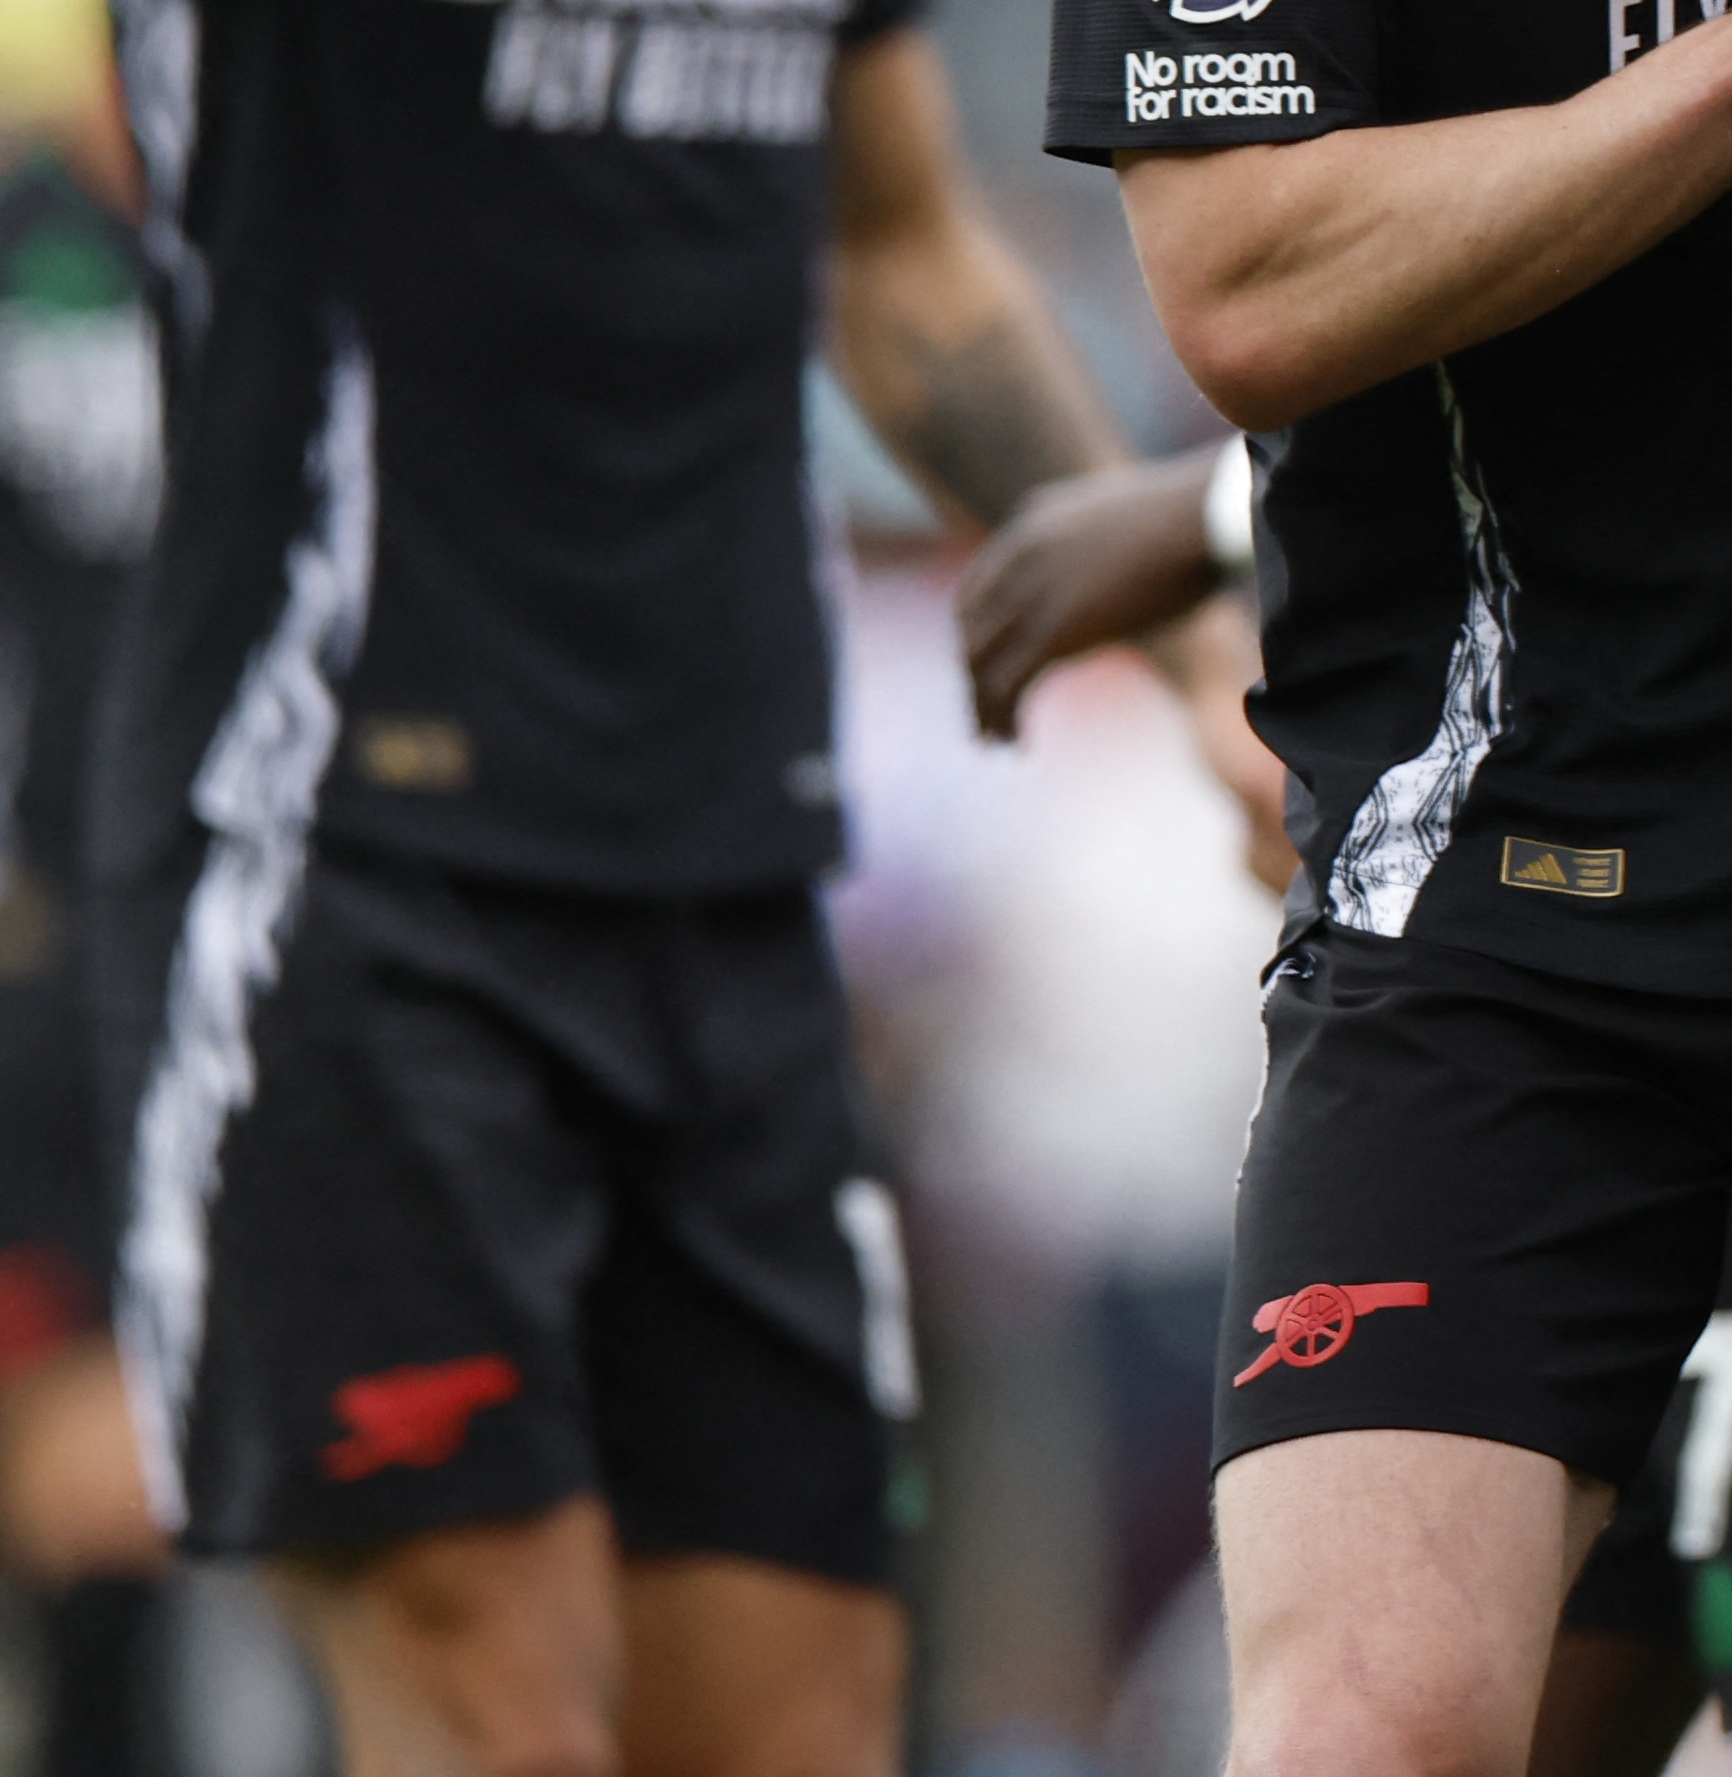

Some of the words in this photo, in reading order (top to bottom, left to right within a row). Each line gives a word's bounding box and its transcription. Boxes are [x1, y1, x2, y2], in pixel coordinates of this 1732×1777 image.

[1125, 51, 1177, 88] No
[1183, 52, 1296, 85] room
[1126, 86, 1177, 122] for
[1180, 85, 1315, 116] racism
